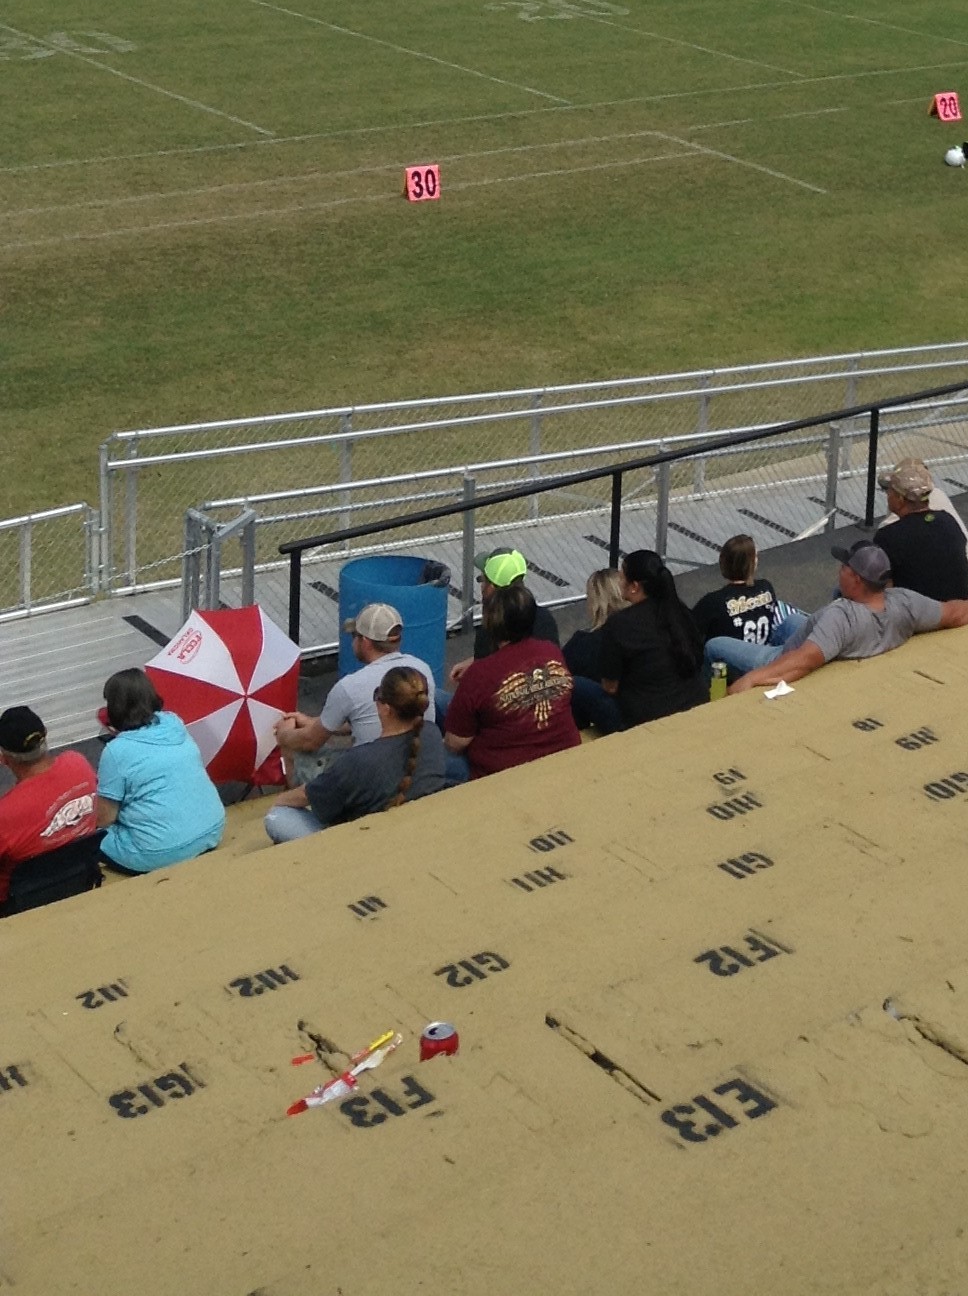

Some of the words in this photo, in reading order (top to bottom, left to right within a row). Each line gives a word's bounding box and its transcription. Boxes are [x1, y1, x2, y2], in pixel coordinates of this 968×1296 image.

[939, 96, 960, 119] 20
[410, 170, 438, 198] 30
[894, 730, 939, 751] H9
[717, 852, 774, 880] G11
[433, 951, 510, 988] G12
[693, 930, 782, 977] F12
[108, 1072, 196, 1119] G13
[339, 1075, 436, 1129] F13
[660, 1078, 779, 1143] E13
